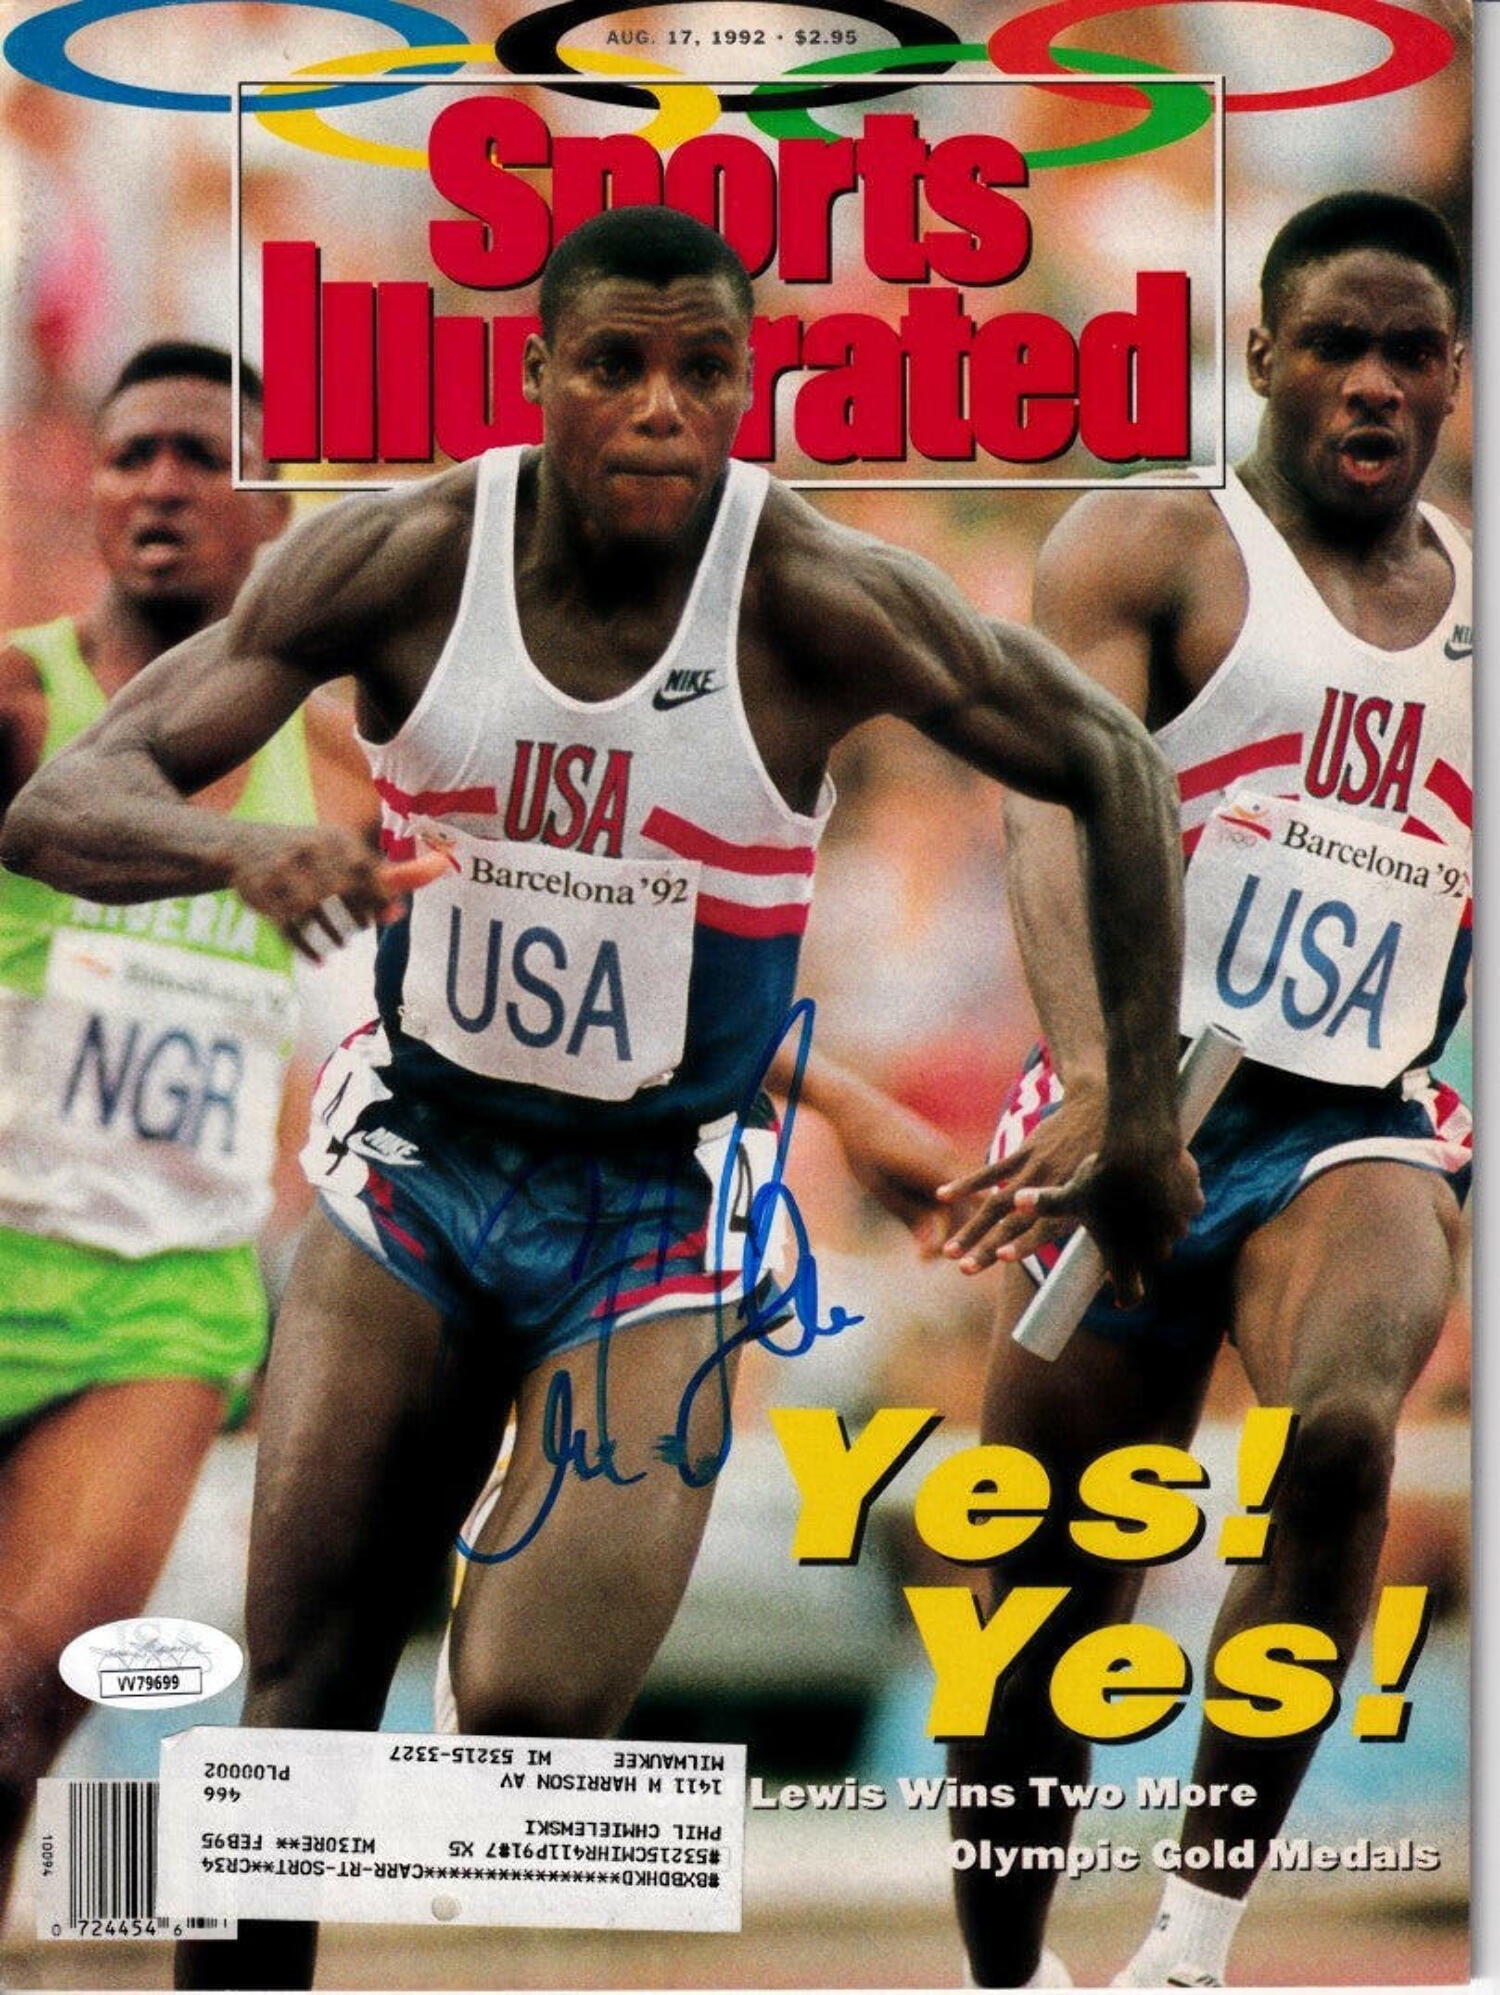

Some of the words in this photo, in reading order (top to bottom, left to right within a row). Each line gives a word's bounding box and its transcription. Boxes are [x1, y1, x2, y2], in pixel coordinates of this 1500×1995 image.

[606, 30, 655, 45] AUG.
[668, 30, 700, 46] 17,
[712, 29, 766, 45] 1992
[794, 29, 858, 45] $2.95
[262, 240, 1190, 464] Illurated
[664, 669, 716, 692] NIKE
[1305, 687, 1425, 814] USA
[503, 740, 634, 859] USA
[1284, 820, 1429, 889] Barcelona
[471, 856, 635, 905] Barcelona
[641, 877, 689, 905] '92
[1216, 873, 1402, 1050] USA
[446, 905, 633, 1062] USA
[62, 1014, 244, 1153] NGR
[771, 1407, 1296, 1567] Yes!
[904, 1587, 1430, 1744] Yes!
[117, 1674, 180, 1692] VV79699
[390, 1746, 513, 1764] 53215-3327
[528, 1750, 551, 1765] WI
[614, 1753, 724, 1771] MILWAUKEE
[501, 1774, 525, 1788] AV
[538, 1774, 636, 1791] HARRISON
[649, 1778, 660, 1792] W
[675, 1778, 721, 1794] 1411
[204, 1787, 240, 1802] 466
[750, 1777, 887, 1810] Lewis
[899, 1777, 1017, 1810] Wins
[1029, 1777, 1126, 1810] Two
[1137, 1777, 1258, 1810] More
[526, 1820, 659, 1838] CHMIELEWSKI
[674, 1825, 721, 1841] PHIL
[202, 1833, 262, 1850] FEB95
[449, 1841, 473, 1856] X5
[948, 1839, 1141, 1880] Olympic
[1151, 1838, 1256, 1872] Gold
[1269, 1838, 1442, 1872] Medals
[78, 1919, 157, 1937] 724454
[173, 1923, 183, 1937] 6
